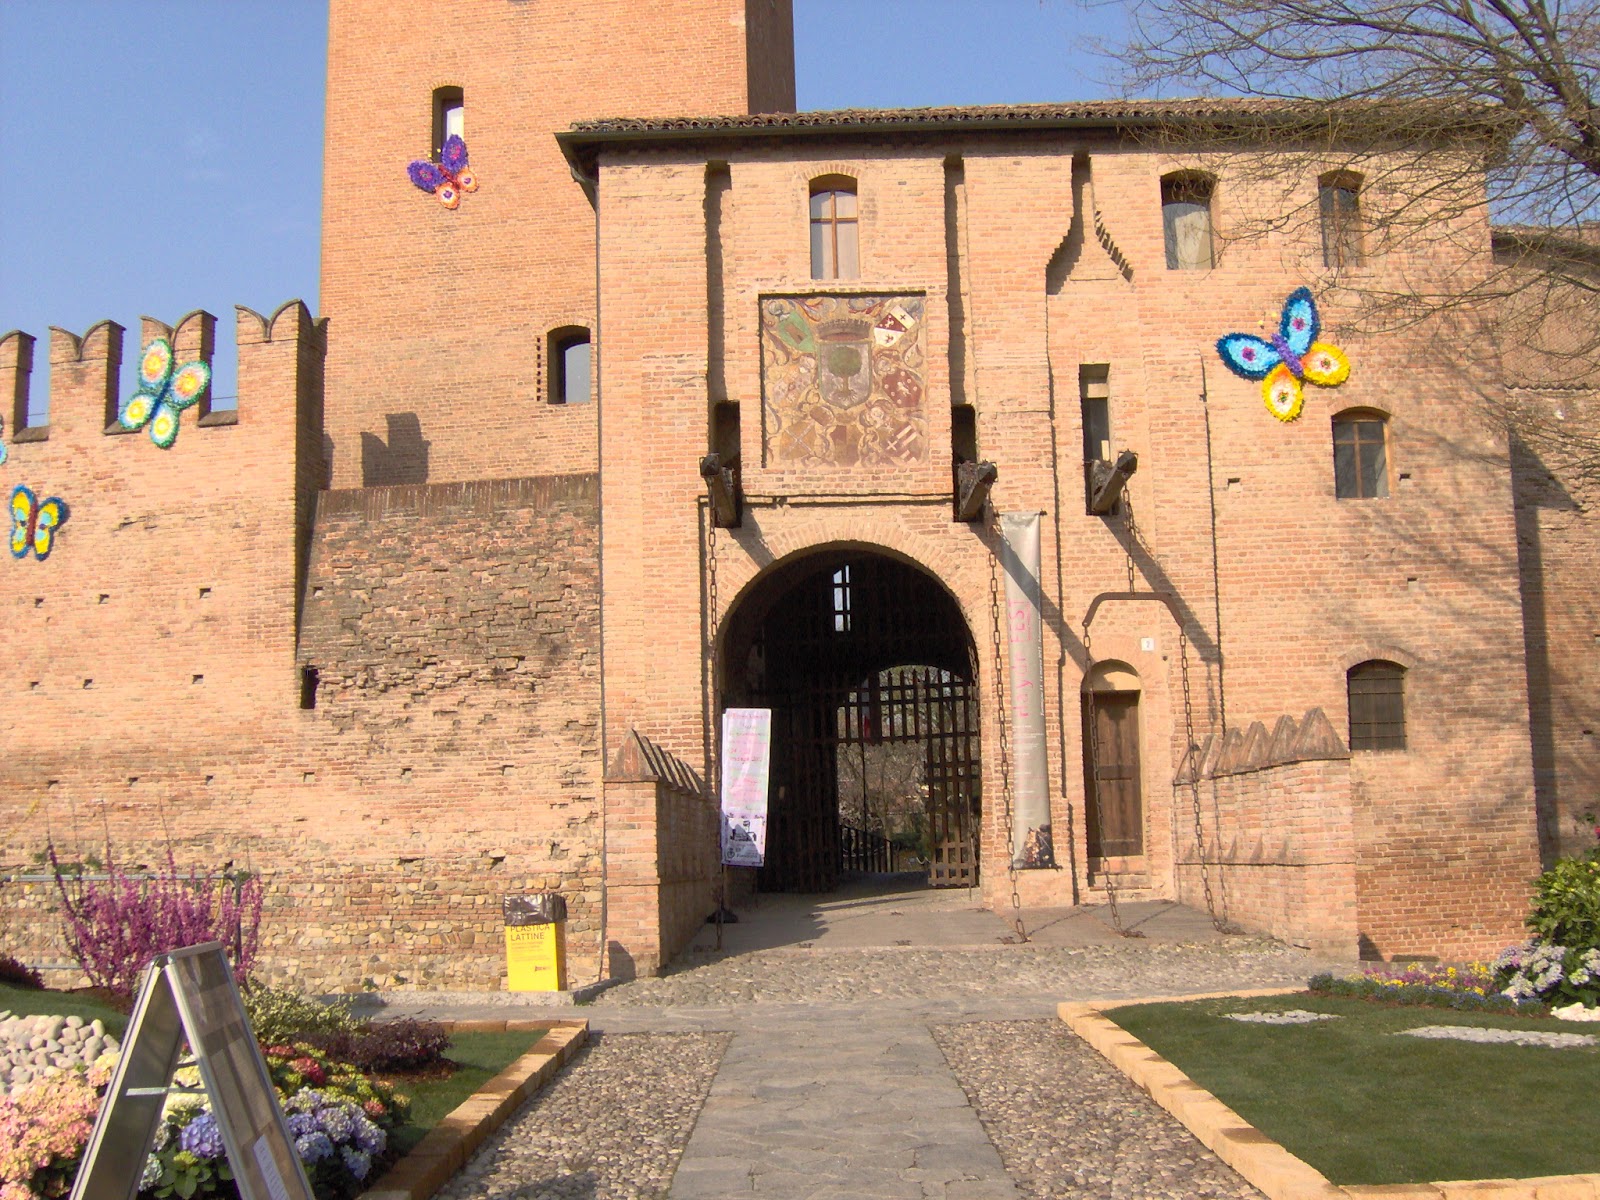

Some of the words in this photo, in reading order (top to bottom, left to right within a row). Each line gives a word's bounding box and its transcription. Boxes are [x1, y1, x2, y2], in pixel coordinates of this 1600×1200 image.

[1008, 598, 1026, 643] FEST
[511, 923, 550, 932] PLASTICA
[511, 932, 544, 941] LATTINE
